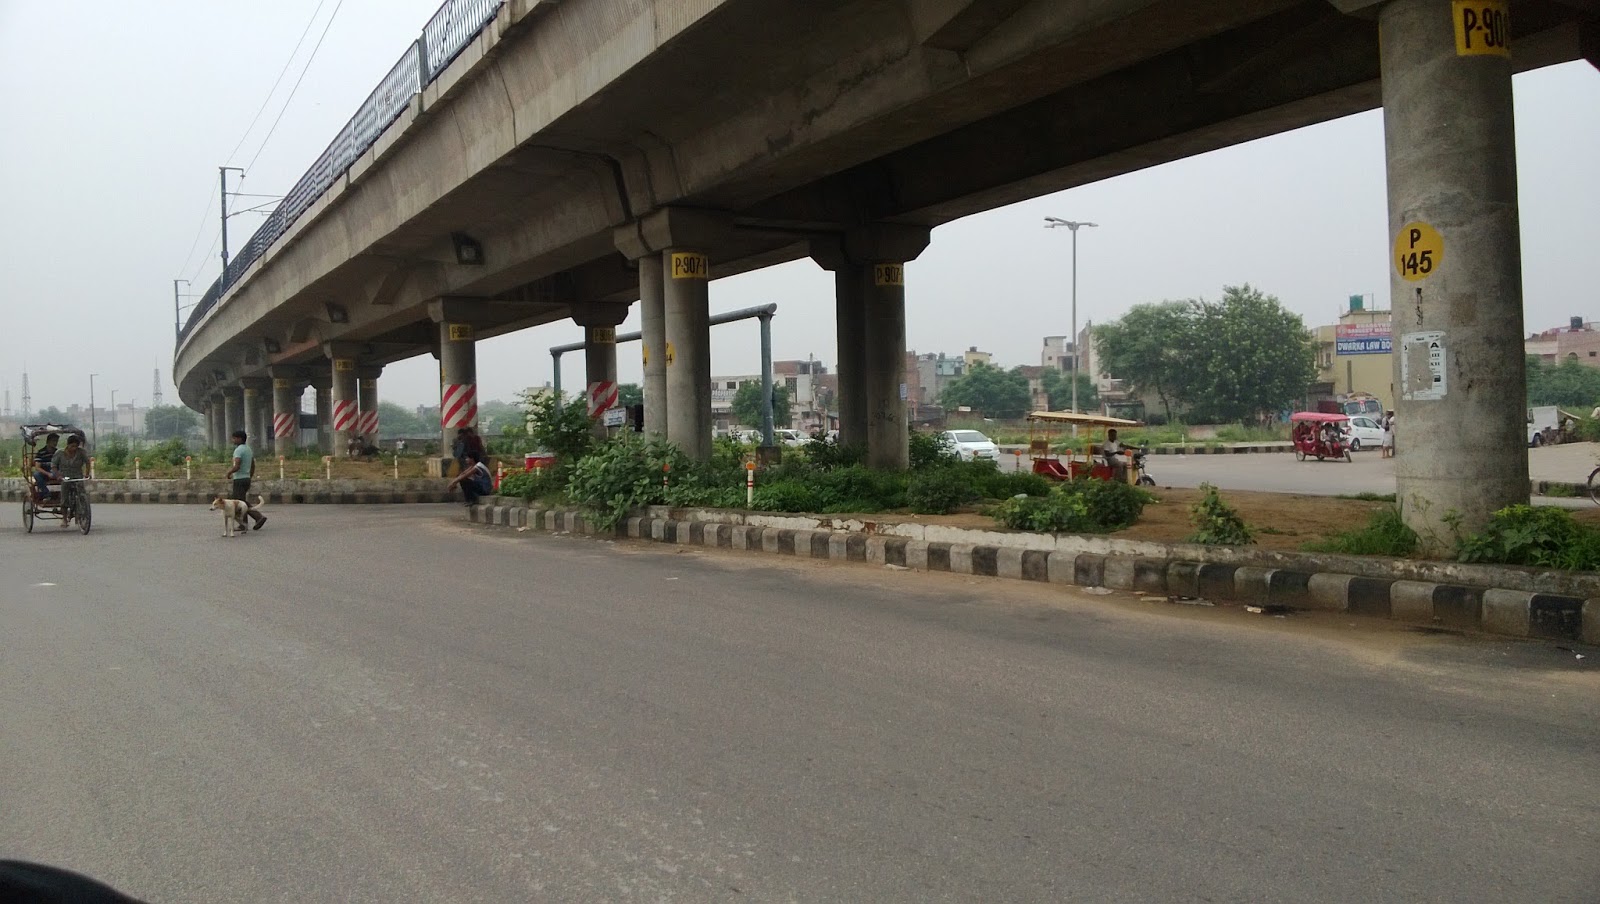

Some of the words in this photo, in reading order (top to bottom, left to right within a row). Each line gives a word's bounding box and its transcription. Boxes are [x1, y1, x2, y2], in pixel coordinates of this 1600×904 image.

[1410, 228, 1421, 249] P
[1401, 250, 1432, 276] 145
[1337, 341, 1365, 351] DWARKA
[1366, 341, 1380, 350] LAW
[1381, 340, 1392, 350] BO
